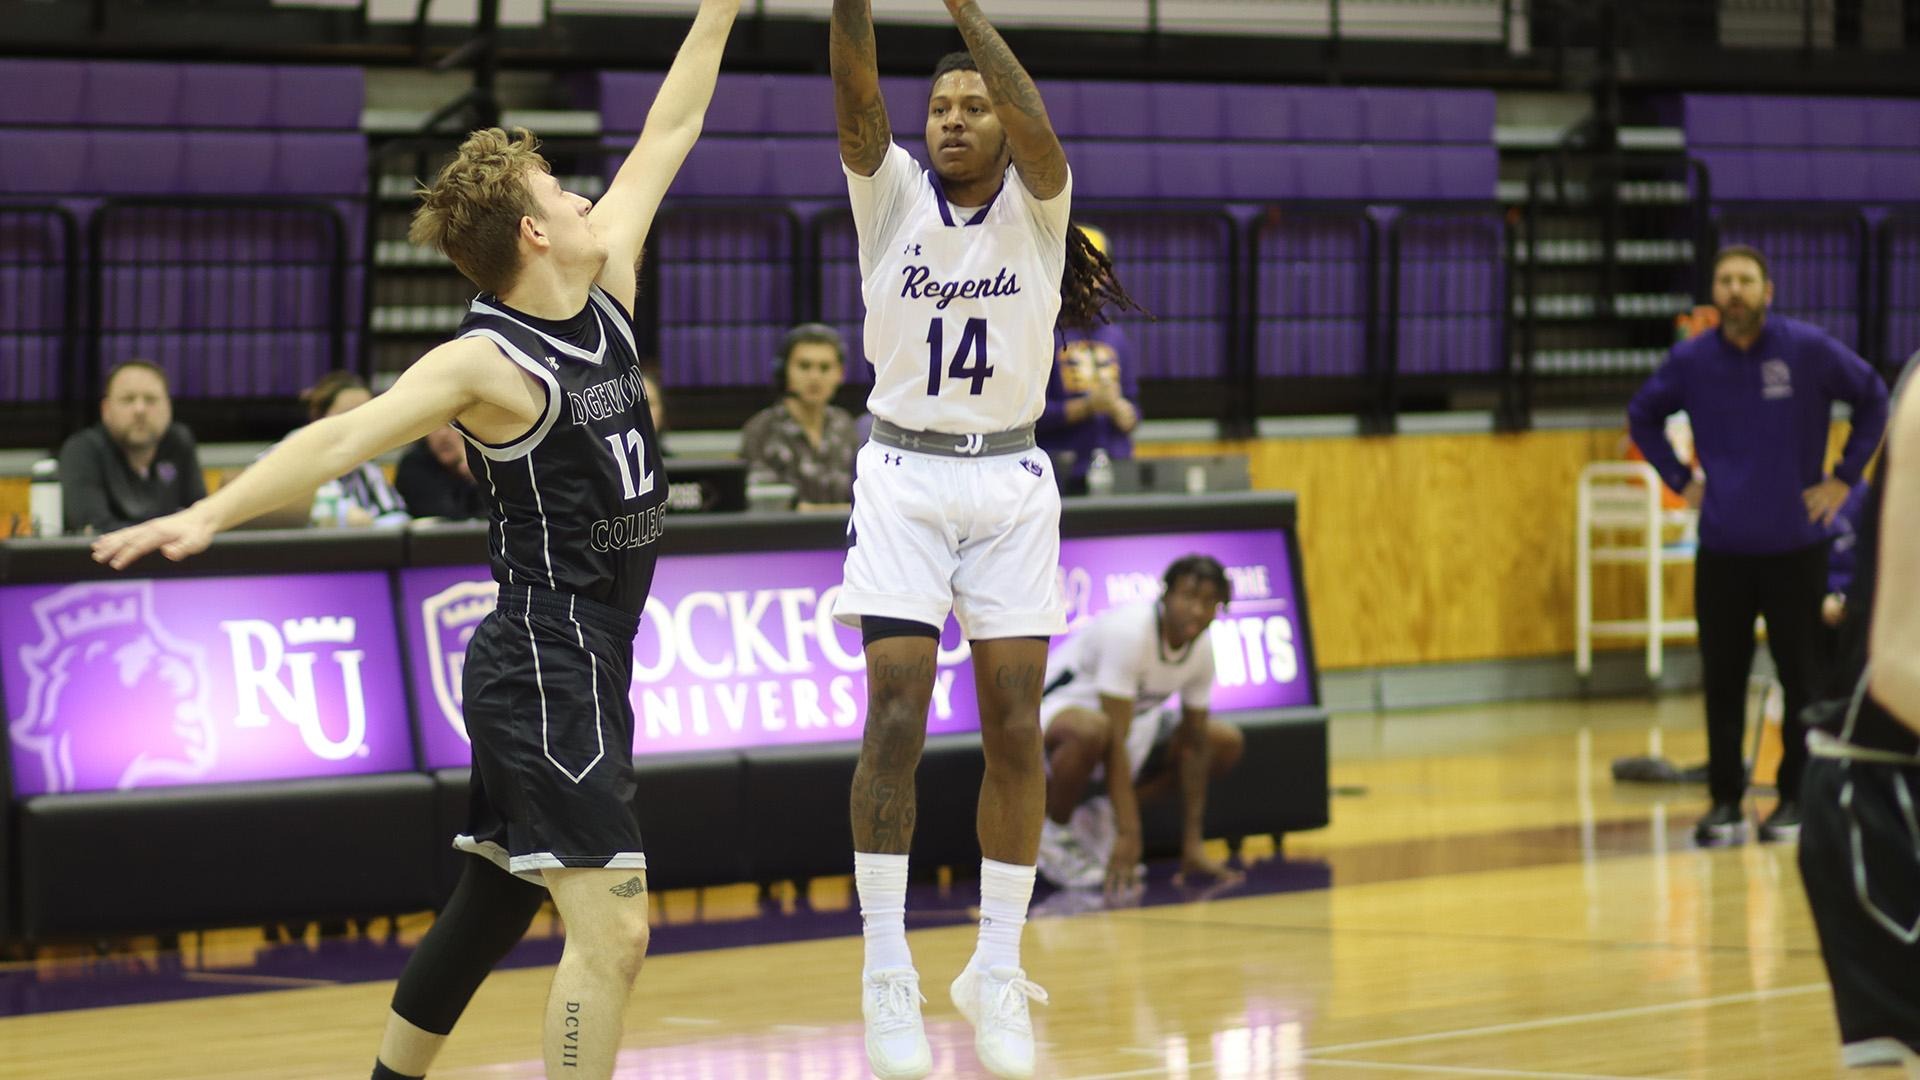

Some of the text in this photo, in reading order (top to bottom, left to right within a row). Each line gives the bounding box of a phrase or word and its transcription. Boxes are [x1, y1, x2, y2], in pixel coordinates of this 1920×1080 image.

[900, 265, 1021, 309] Regents
[926, 317, 994, 396] 14
[604, 428, 654, 500] 12
[590, 502, 667, 552] COLLEG
[1209, 615, 1298, 687] NTS
[219, 618, 366, 760] RU
[562, 1001, 580, 1067] DCVIII
